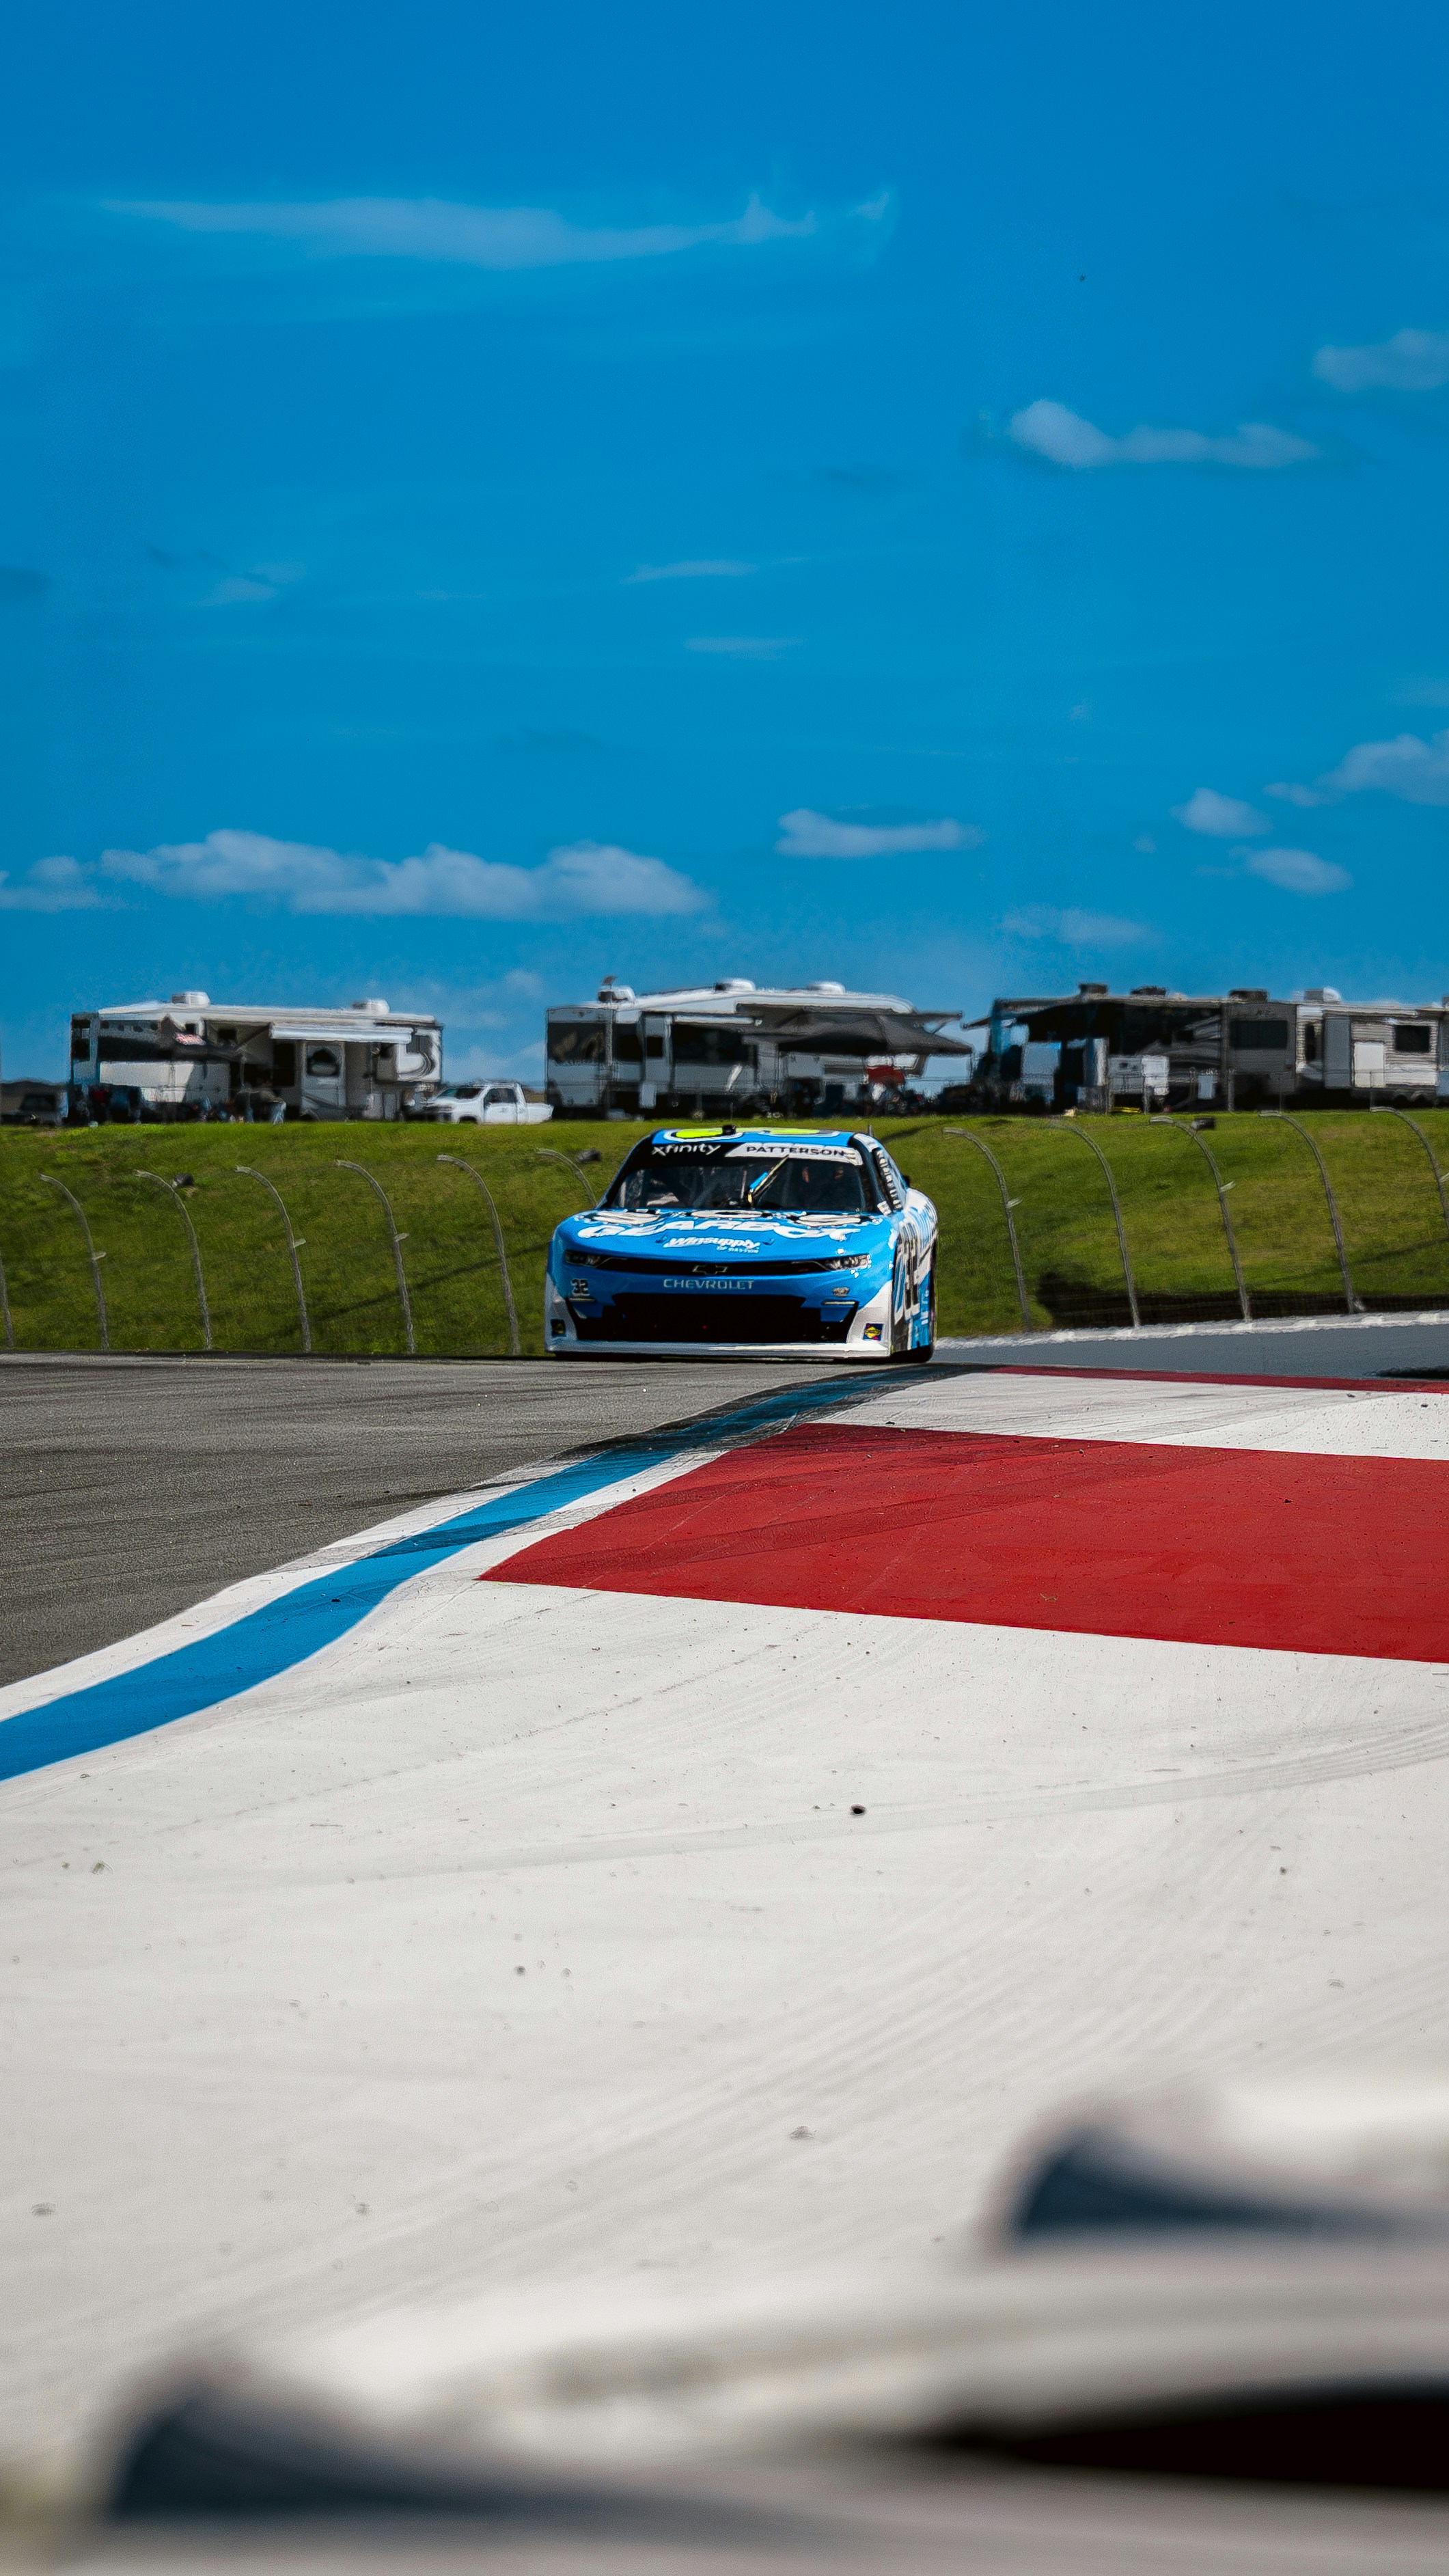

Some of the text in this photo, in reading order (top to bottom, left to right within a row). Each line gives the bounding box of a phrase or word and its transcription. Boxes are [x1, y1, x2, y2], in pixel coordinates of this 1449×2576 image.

[651, 1144, 721, 1156] xfinity
[746, 1146, 844, 1156] PATTERSON
[663, 1237, 760, 1249] Winsupply
[570, 1278, 590, 1296] 32
[663, 1278, 754, 1289] CHEVROLET
